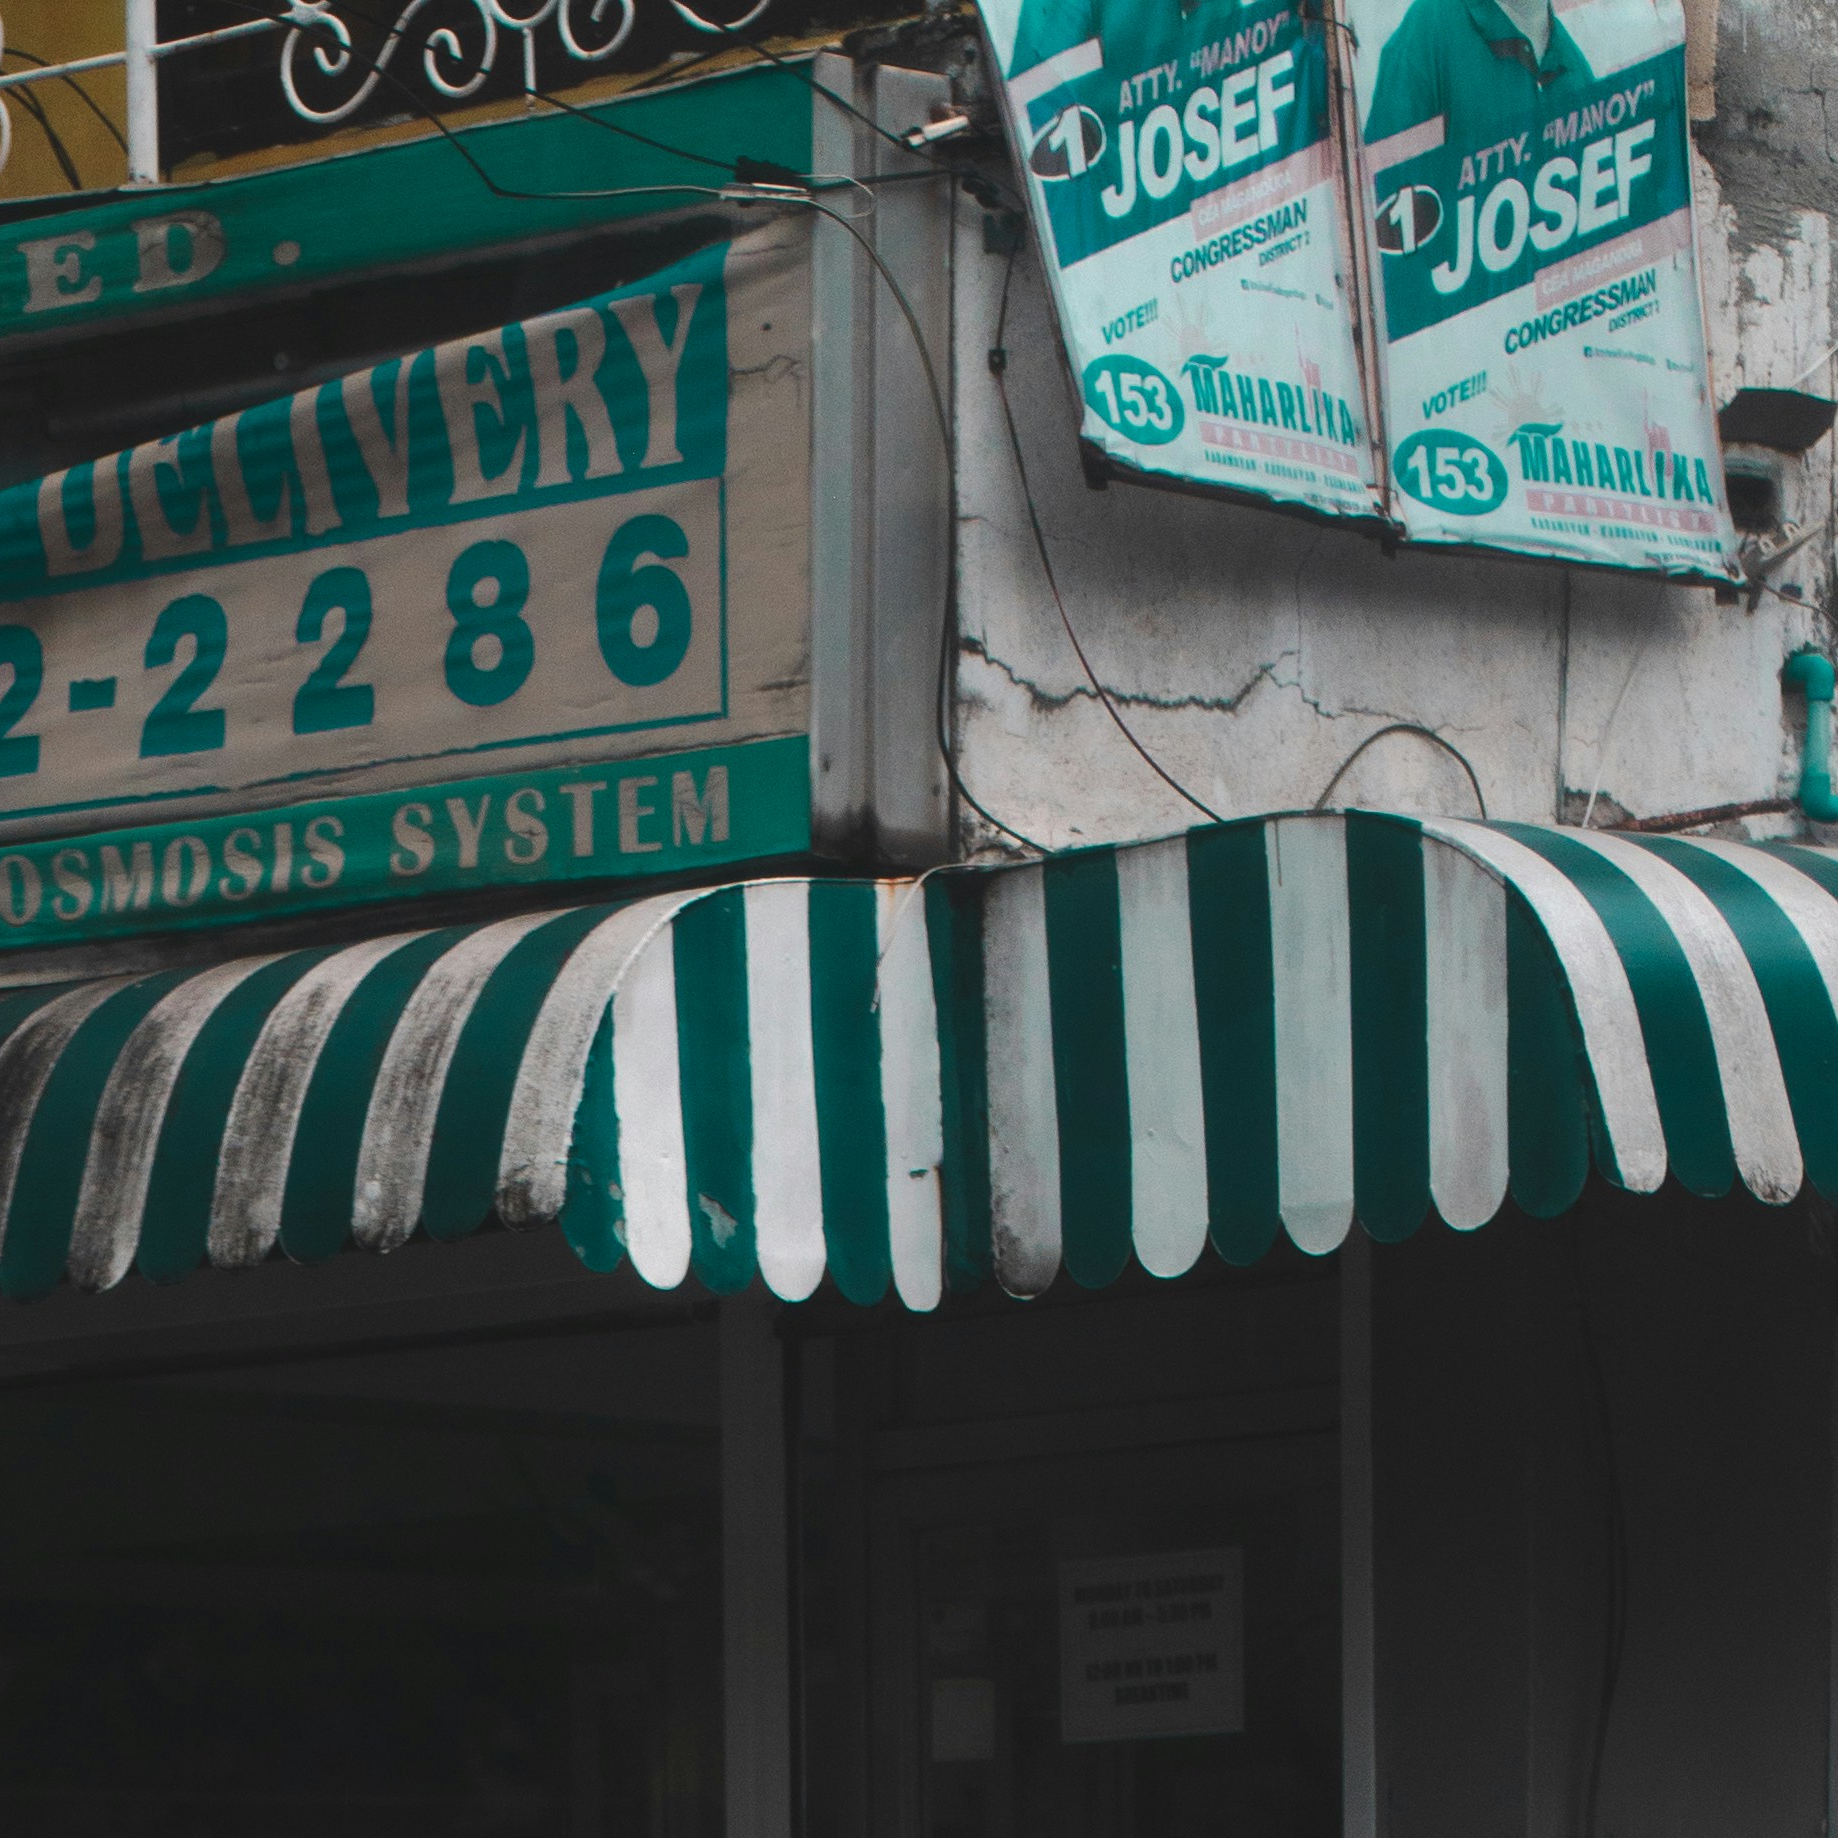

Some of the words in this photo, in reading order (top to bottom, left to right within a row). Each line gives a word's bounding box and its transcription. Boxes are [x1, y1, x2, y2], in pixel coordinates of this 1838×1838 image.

[1119, 60, 1182, 115] ATTY.
[1101, 51, 1295, 218] JOSEF
[1458, 132, 1531, 191] ATTY.
[1170, 198, 1307, 284] CONGRESSMAN
[1431, 118, 1655, 294] JOSEF
[1505, 268, 1656, 354] CONGRESSMAN
[35, 282, 705, 582] DELIVERY
[1094, 370, 1174, 431] 153
[1182, 358, 1357, 447] MAHARLIKA
[1407, 444, 1495, 502] 153
[1509, 428, 1715, 506] MAHARLIKA
[389, 763, 732, 878] SYSTEM
